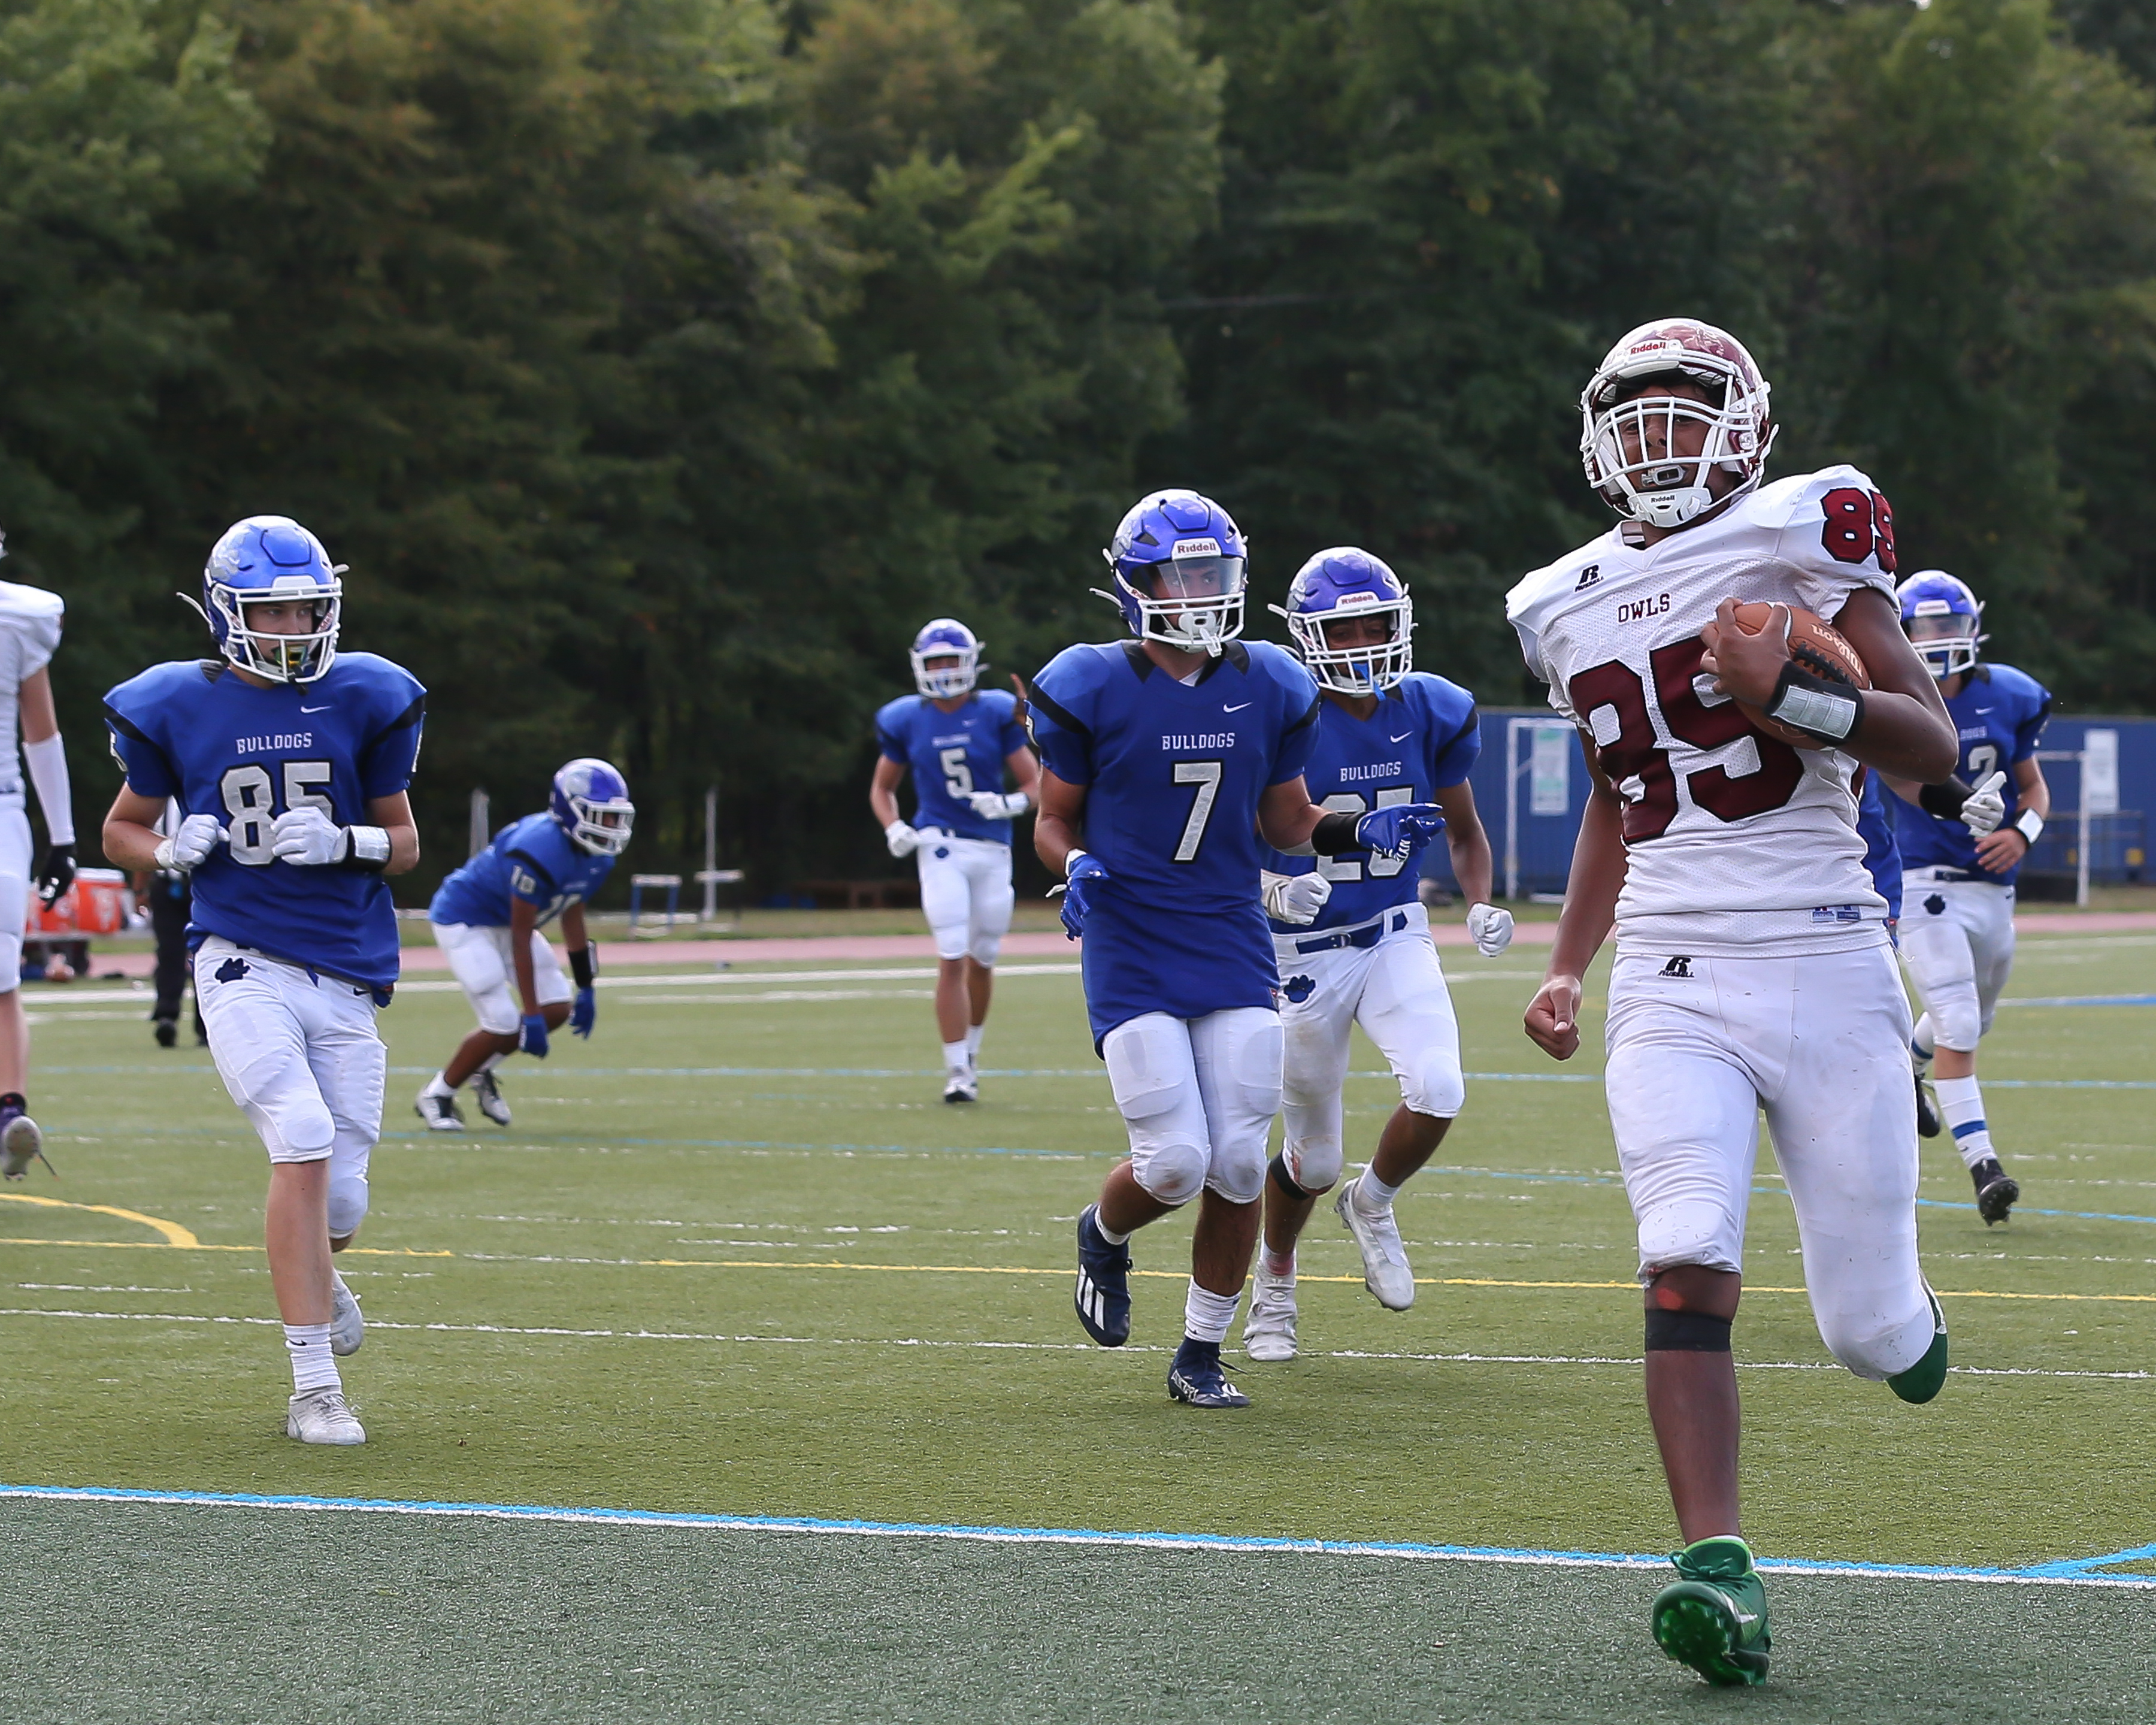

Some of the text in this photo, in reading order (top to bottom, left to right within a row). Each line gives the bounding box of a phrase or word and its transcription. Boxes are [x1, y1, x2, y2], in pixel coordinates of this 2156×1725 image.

[1631, 341, 1666, 355] Riddell
[1651, 495, 1675, 503] Riddell
[1177, 543, 1217, 553] Riddell
[1342, 595, 1373, 604] Riddell
[1618, 593, 1670, 623] OWLS
[1810, 624, 1863, 678] Wilson
[235, 732, 313, 755] BULLDOGS
[1161, 732, 1235, 750] BULLDOGS
[1569, 634, 1804, 846] 85
[939, 746, 974, 800] 5
[1339, 761, 1402, 782] BULLDOGS
[1968, 745, 1997, 790] 2
[220, 761, 333, 866] 85
[1172, 759, 1222, 862] 7
